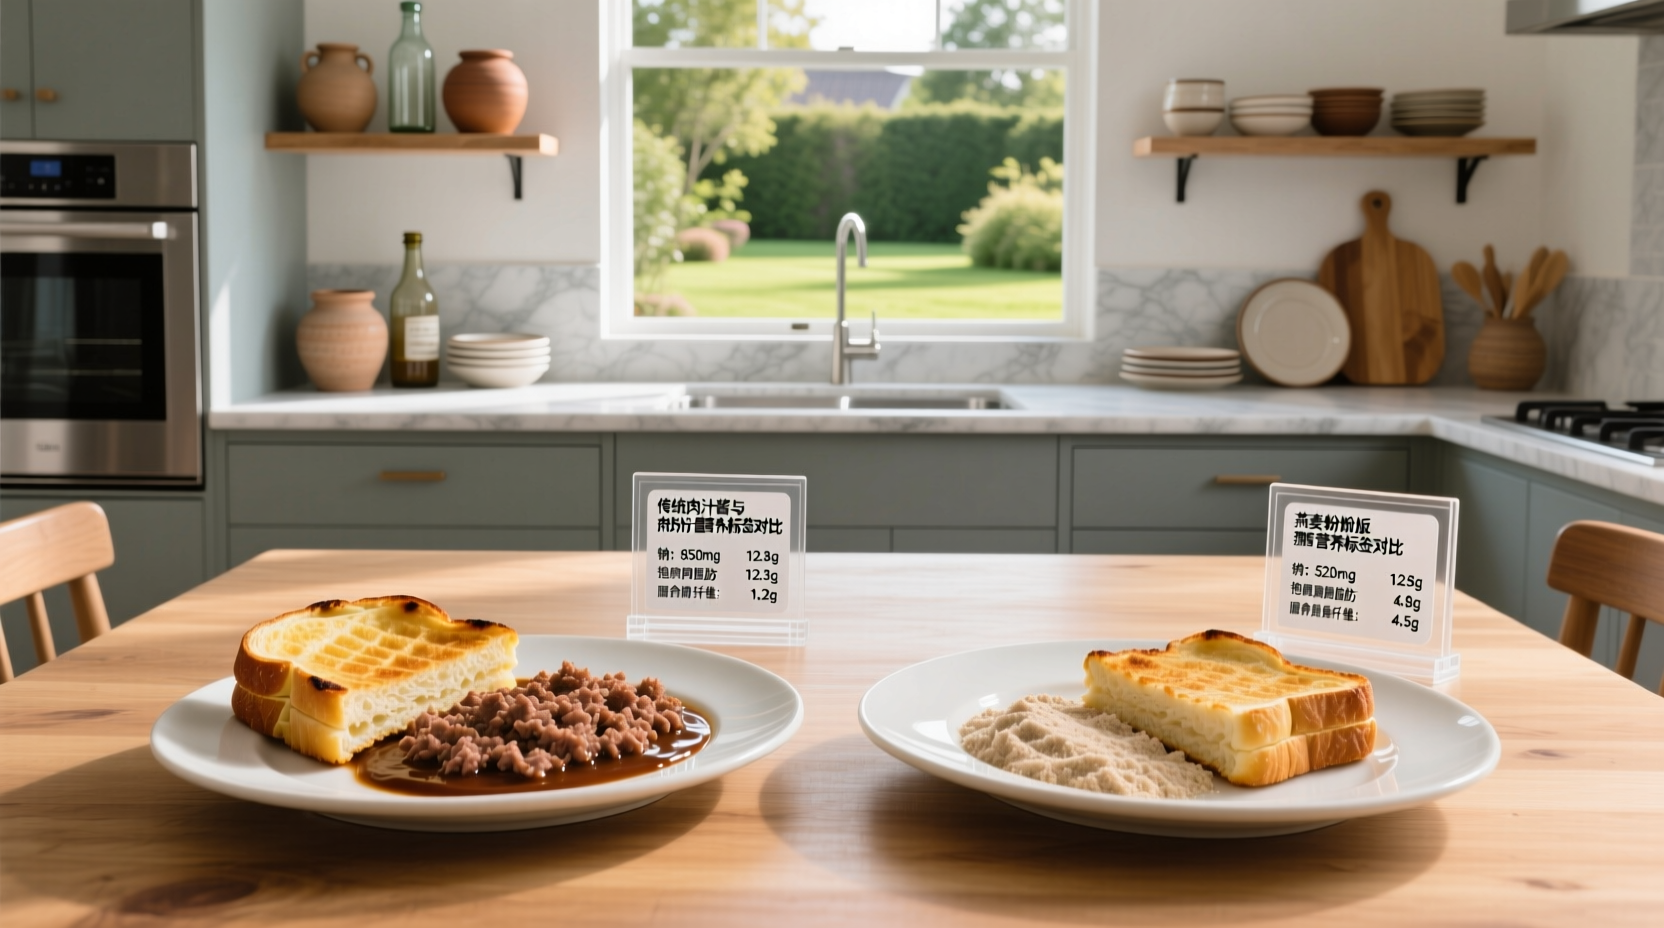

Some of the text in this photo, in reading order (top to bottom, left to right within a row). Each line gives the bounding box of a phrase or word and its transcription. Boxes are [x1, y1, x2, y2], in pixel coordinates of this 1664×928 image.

[680, 548, 720, 564] 850mg
[745, 568, 778, 584] 12.3g
[1314, 564, 1356, 584] 520mg
[750, 588, 778, 603] 1.2g
[1391, 614, 1419, 632] 4.5g
